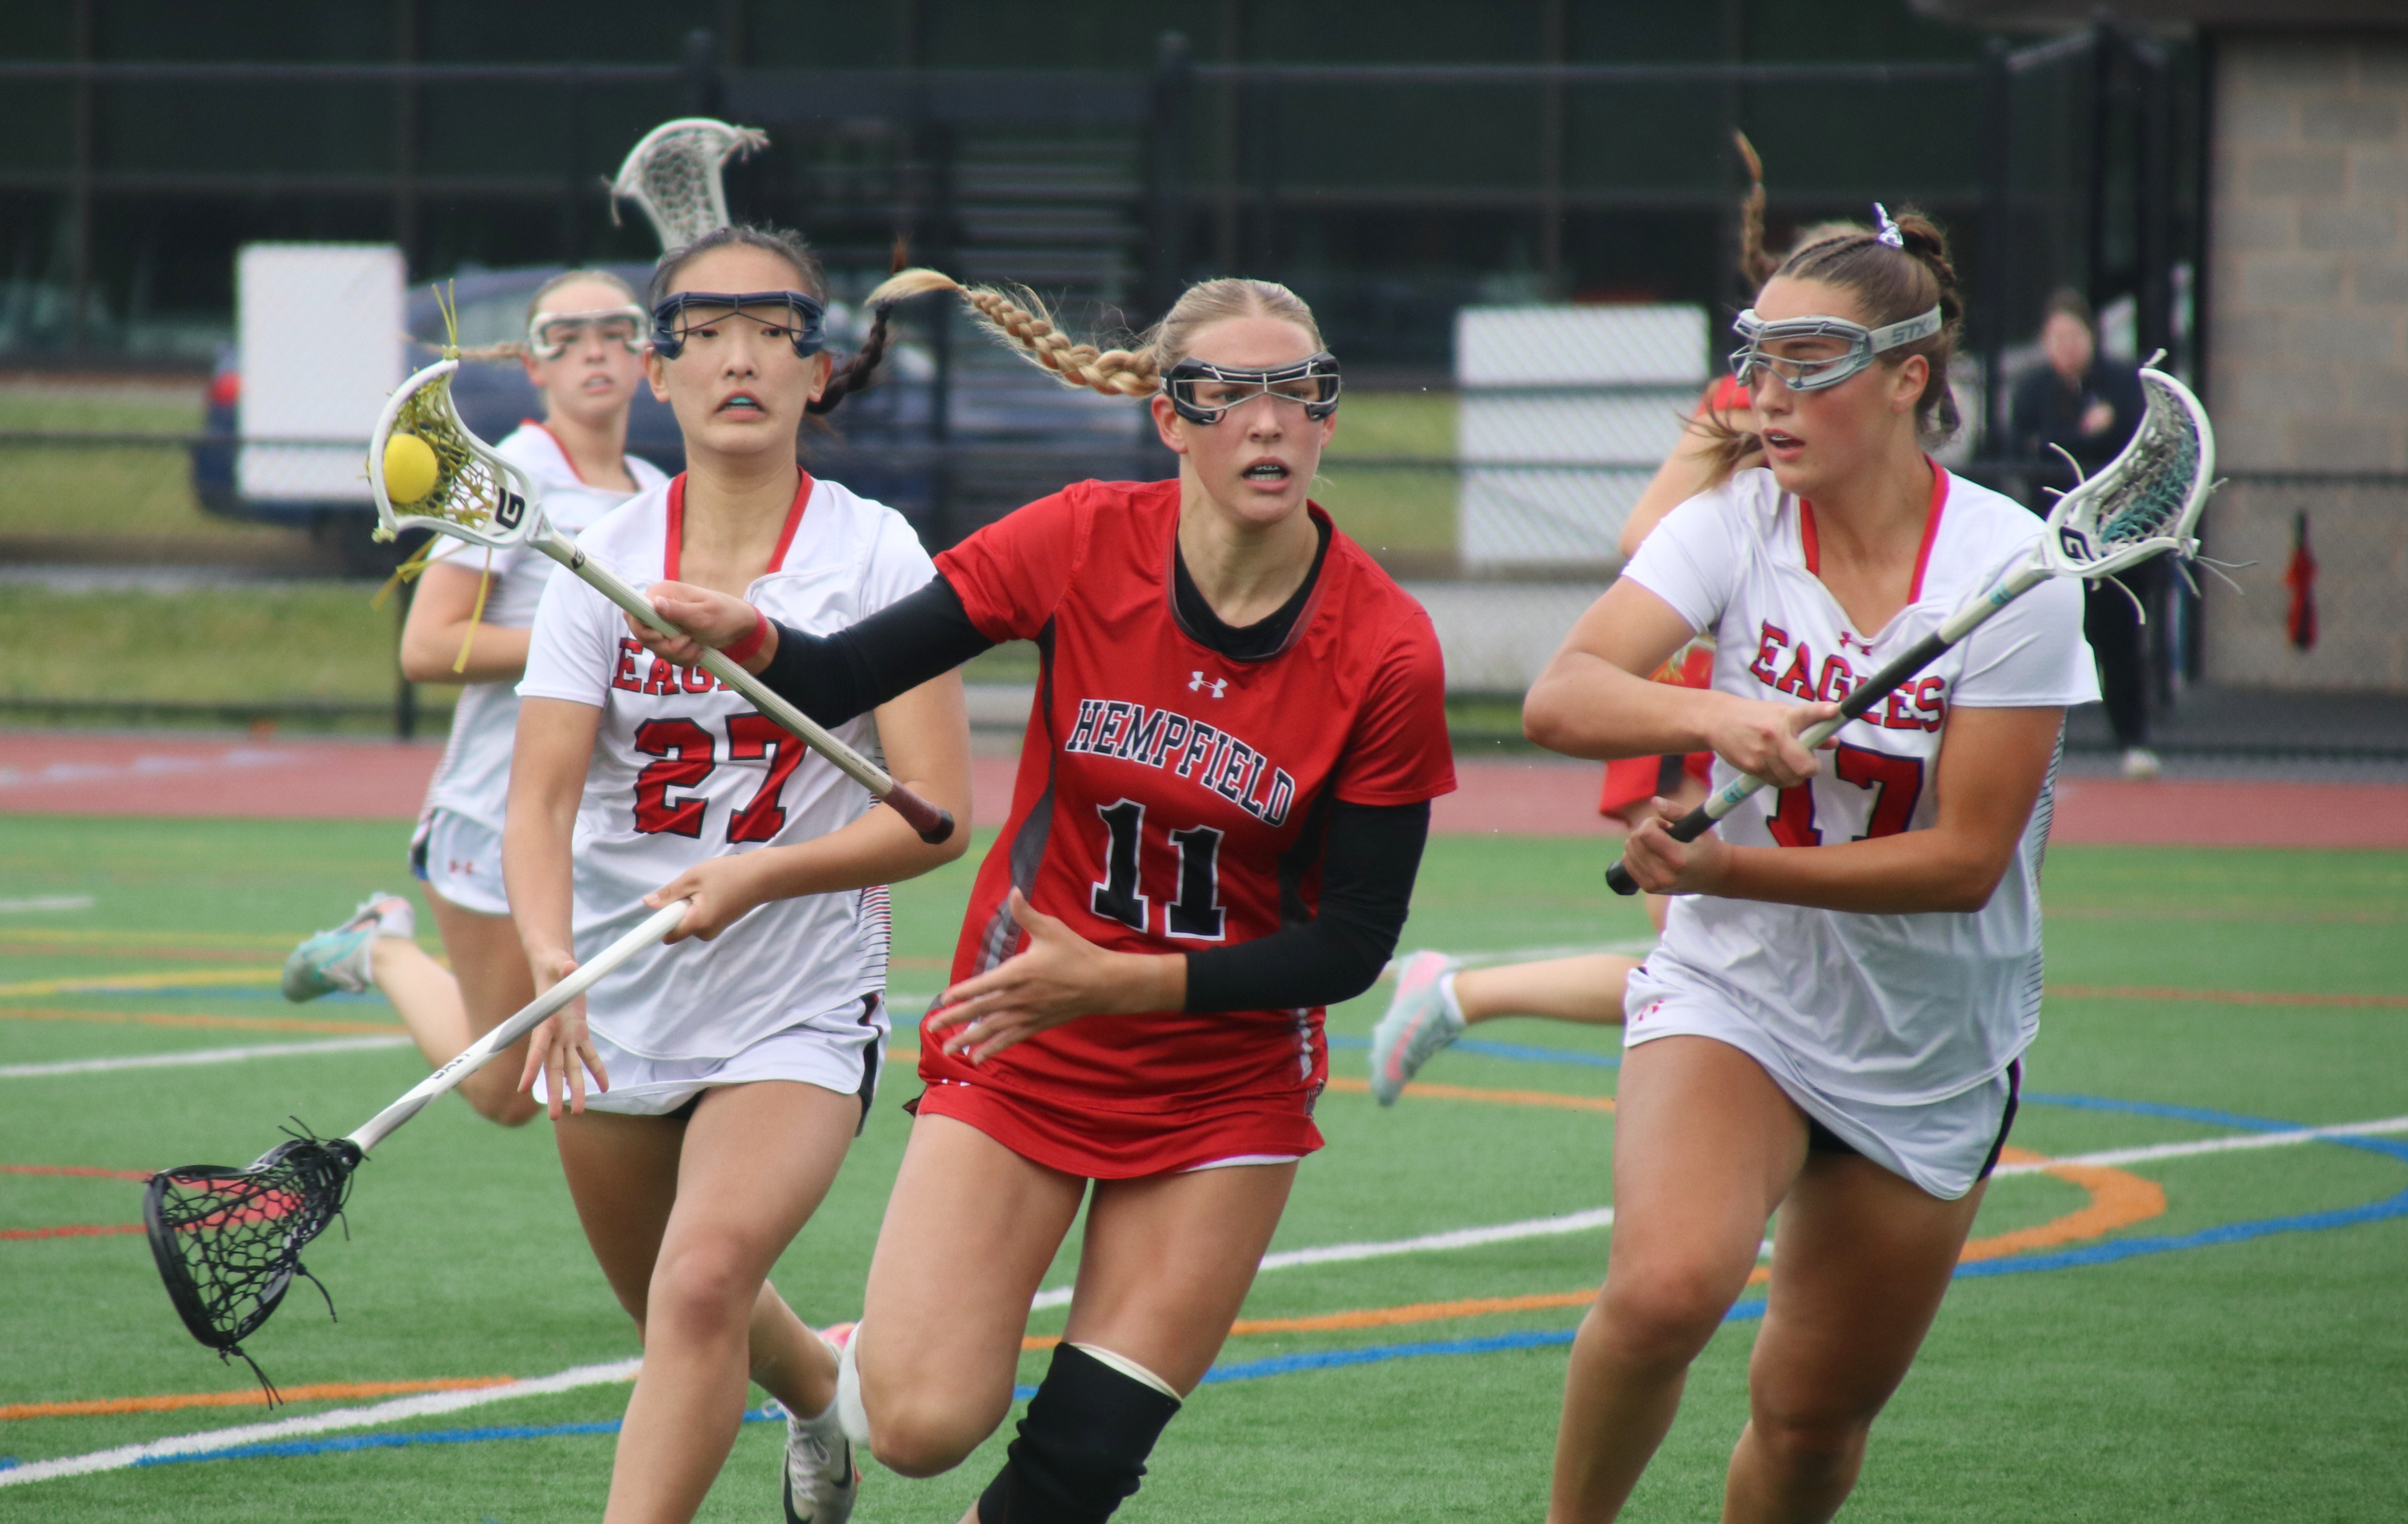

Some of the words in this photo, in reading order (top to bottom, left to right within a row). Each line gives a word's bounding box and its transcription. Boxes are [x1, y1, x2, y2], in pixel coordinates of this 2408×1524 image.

[611, 637, 734, 694] EAG
[1749, 617, 1945, 733] EAGES
[633, 712, 808, 844] 27
[1065, 698, 1295, 828] HEMPFIELD
[1091, 797, 1227, 941] 11
